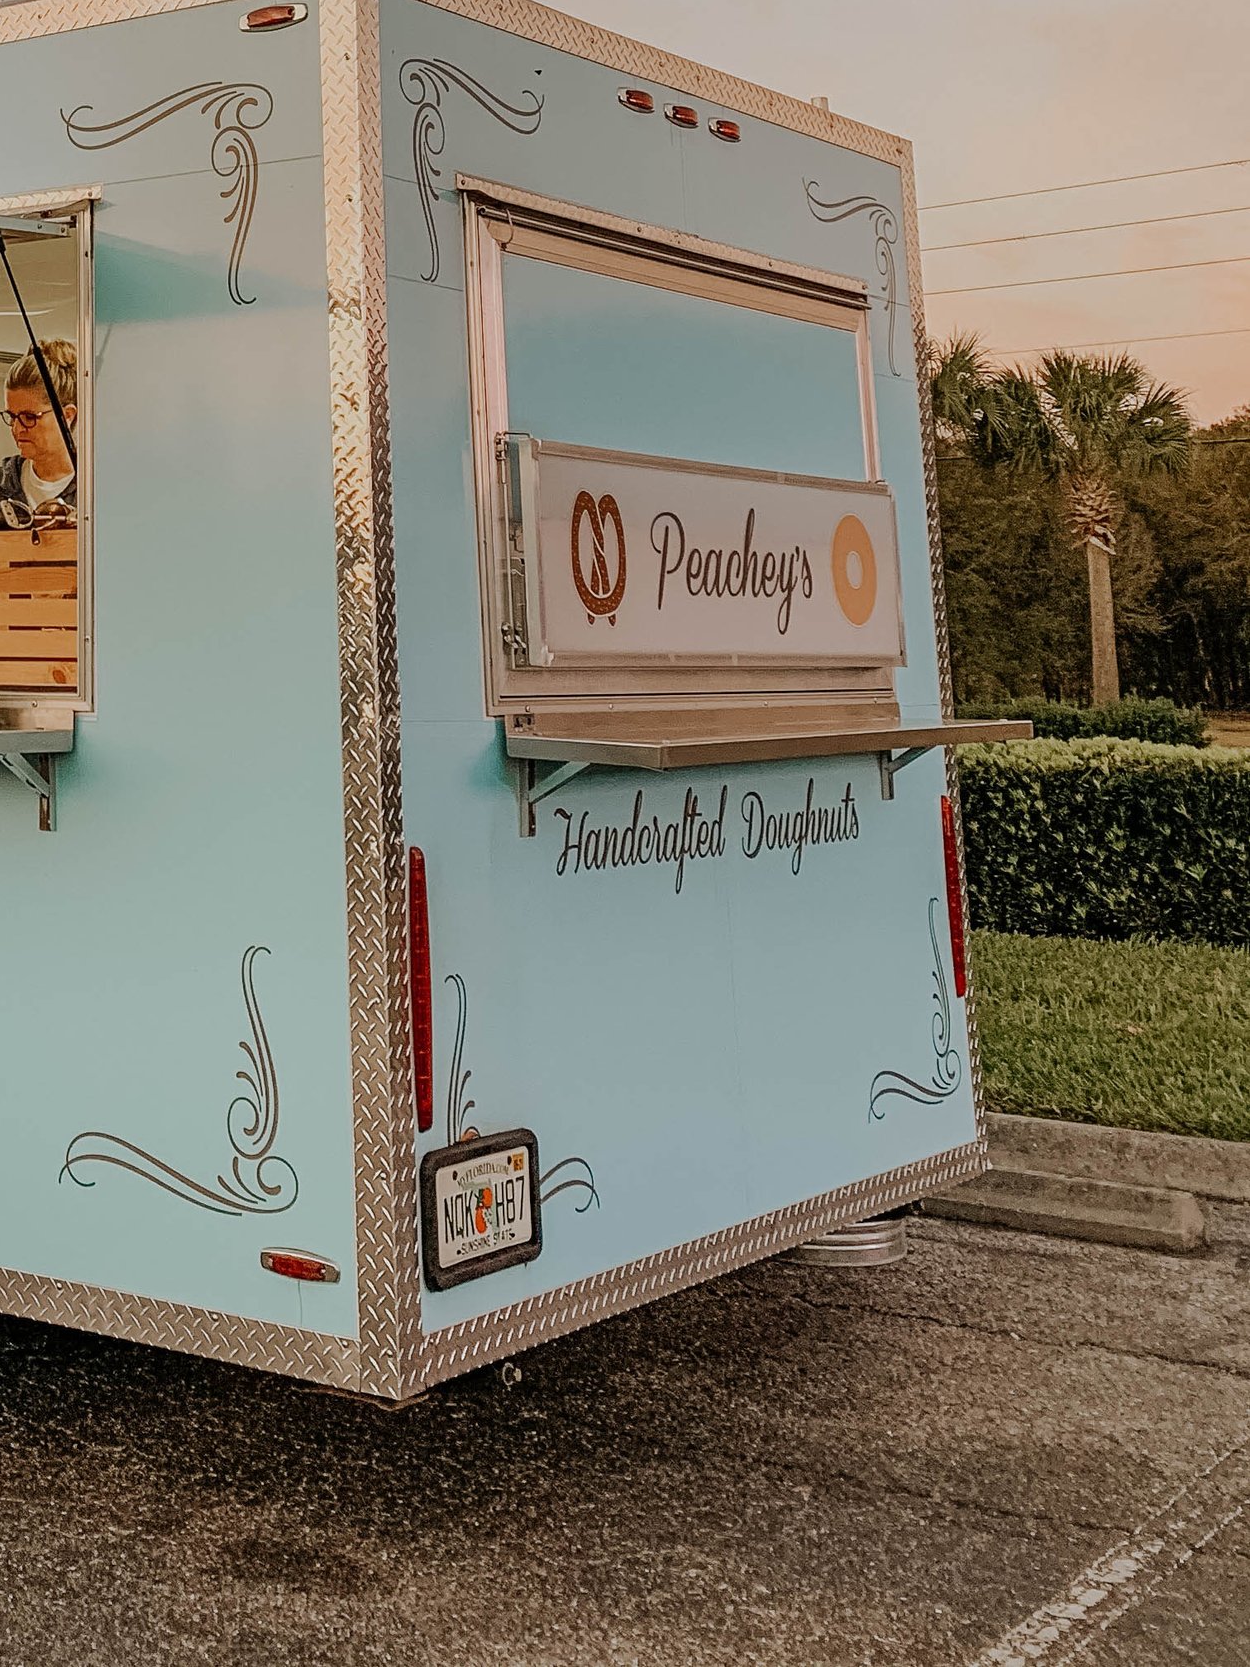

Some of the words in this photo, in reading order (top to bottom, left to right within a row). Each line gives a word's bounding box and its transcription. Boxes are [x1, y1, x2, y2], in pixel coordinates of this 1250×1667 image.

[650, 508, 814, 635] Peachey's
[554, 784, 728, 895] Handcrafted
[740, 777, 860, 876] Doughnuts
